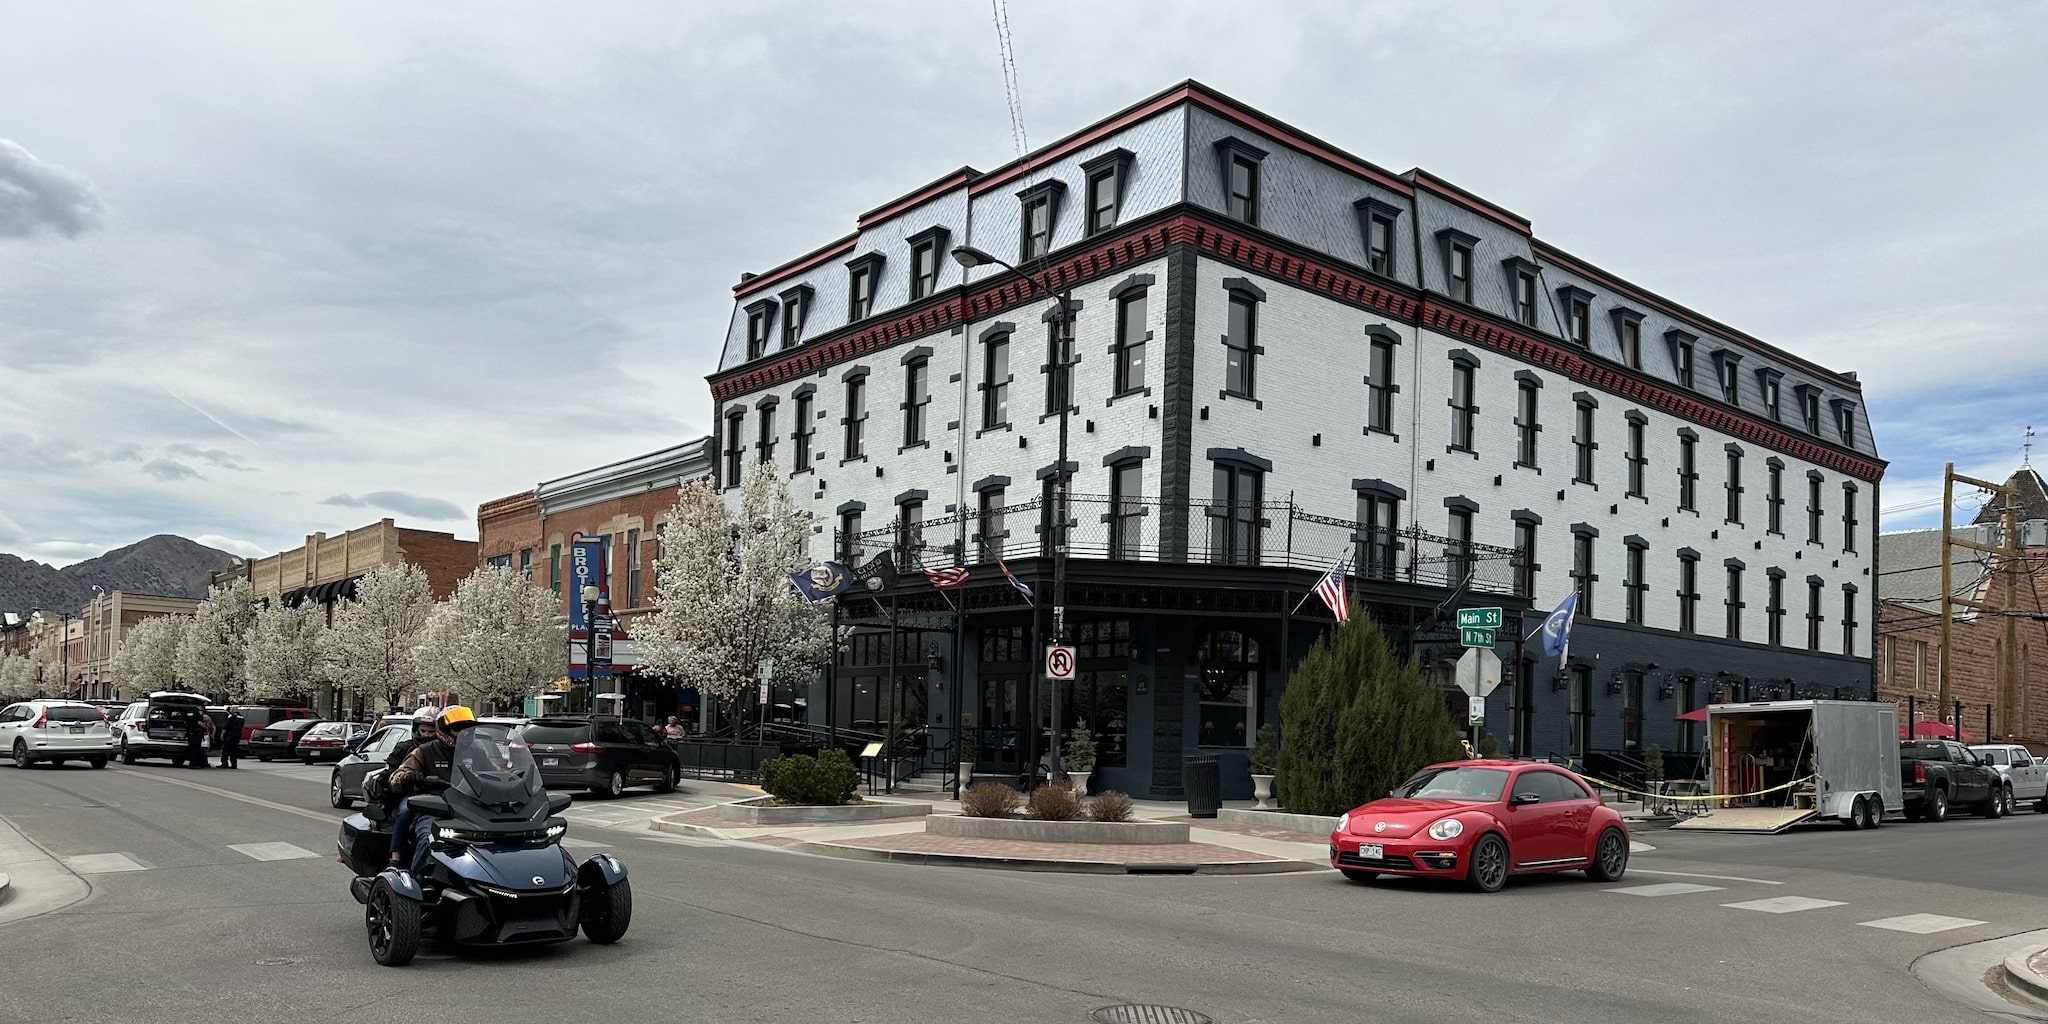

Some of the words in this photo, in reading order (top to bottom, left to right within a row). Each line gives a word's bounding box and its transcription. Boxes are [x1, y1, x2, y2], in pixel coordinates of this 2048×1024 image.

[1460, 613, 1480, 624] Main
[1486, 612, 1497, 623] St
[1466, 631, 1471, 642] N
[1473, 631, 1484, 643] 7th
[1485, 633, 1492, 643] St
